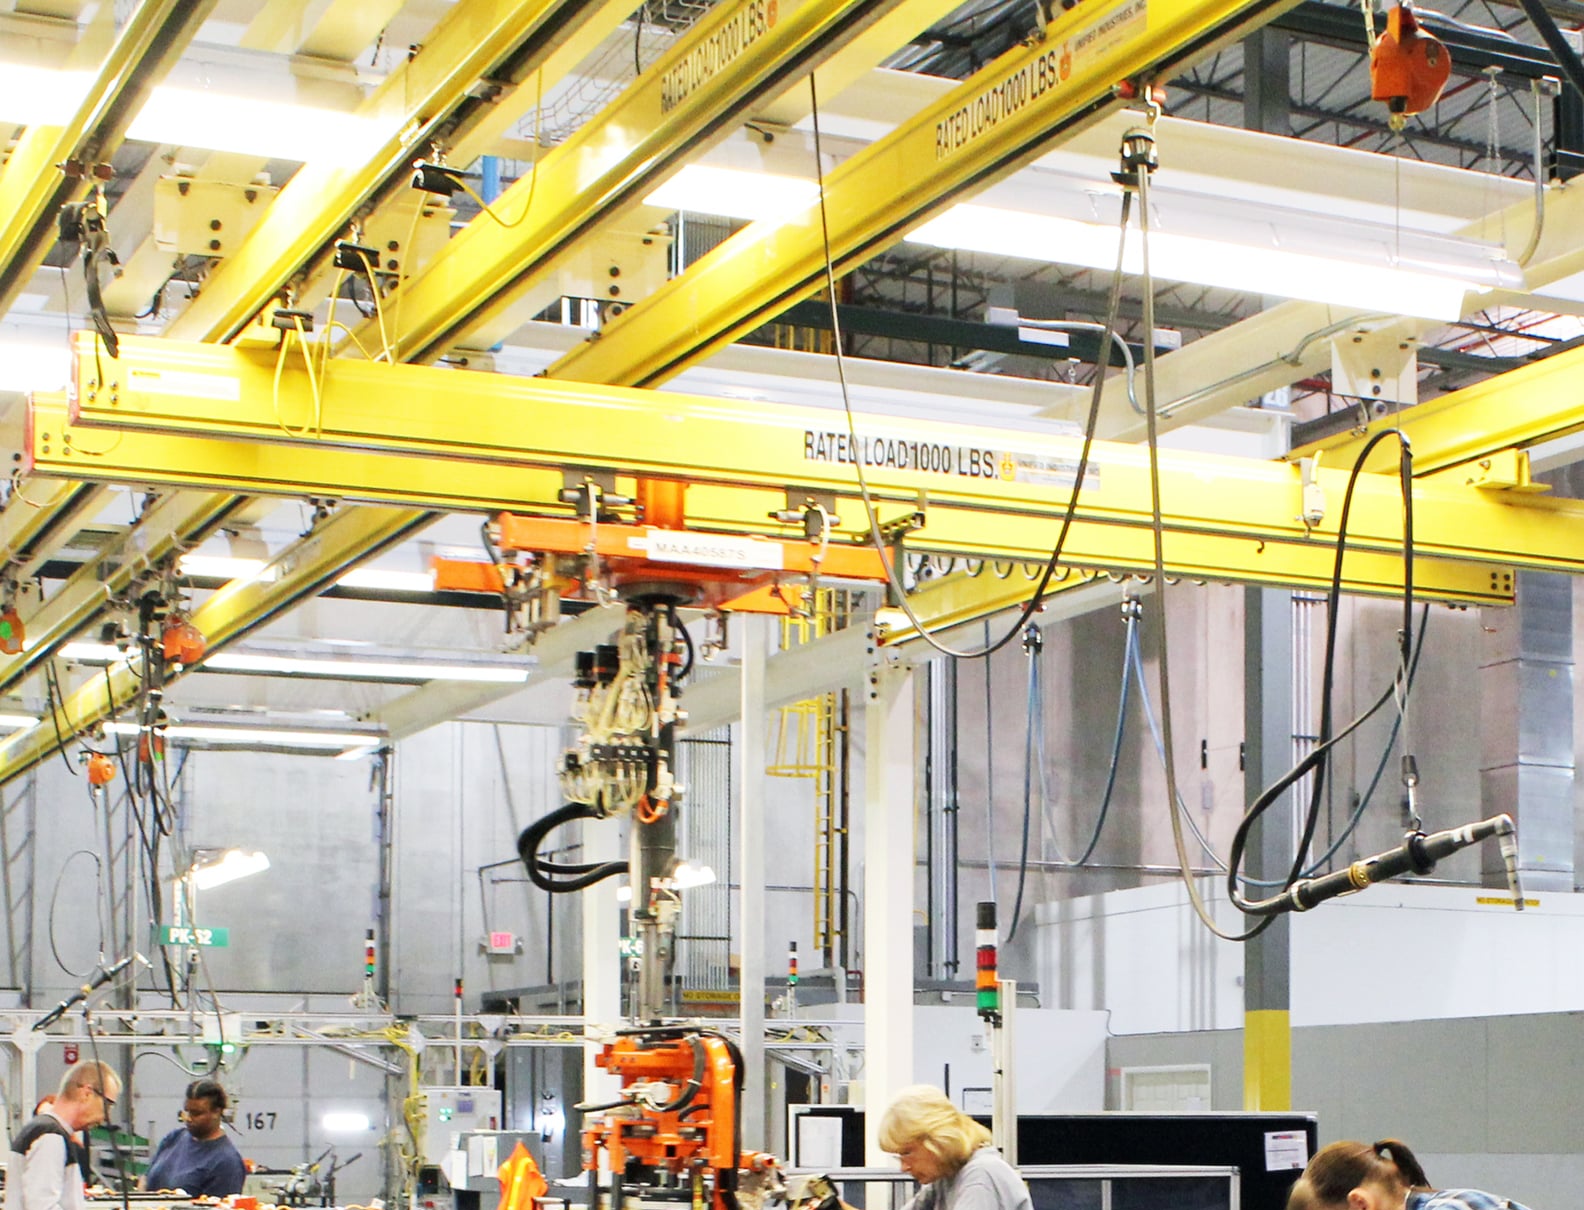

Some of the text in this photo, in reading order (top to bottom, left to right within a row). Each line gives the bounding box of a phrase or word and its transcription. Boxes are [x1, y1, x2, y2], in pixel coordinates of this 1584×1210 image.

[661, 58, 689, 115] RATED
[715, 17, 739, 71] 1000
[936, 50, 1059, 160] RATED LOAD 1000 LBS.
[804, 430, 999, 480] RATED LOAD 1000 LBS.
[493, 933, 512, 948] EXIT
[246, 1112, 277, 1129] 167
